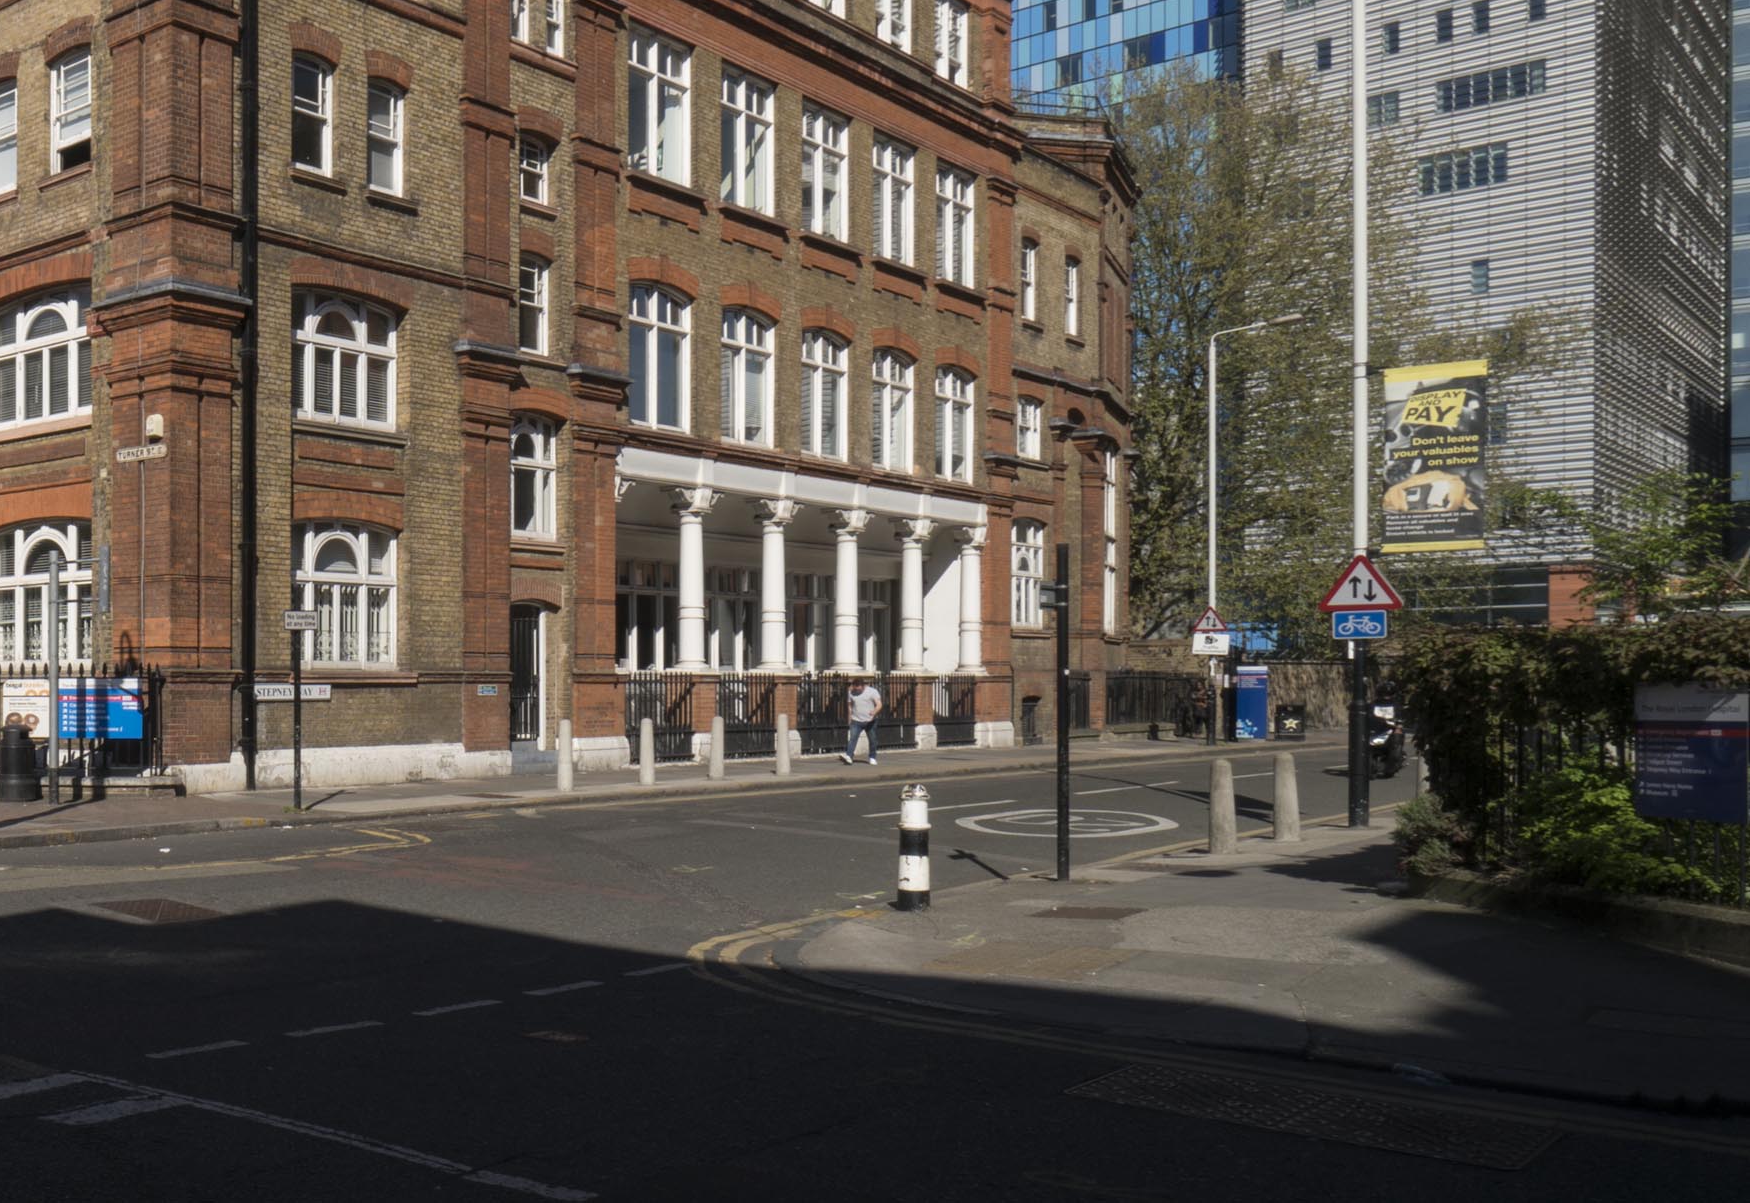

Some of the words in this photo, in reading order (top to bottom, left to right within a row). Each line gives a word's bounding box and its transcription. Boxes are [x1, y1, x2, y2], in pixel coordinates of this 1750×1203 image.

[1409, 391, 1462, 403] DISPLAY
[1418, 399, 1441, 407] AND
[1404, 405, 1457, 423] PAY
[1412, 436, 1445, 446] Don't
[1446, 434, 1479, 444] leave
[1393, 449, 1420, 460] your
[1422, 445, 1480, 457] valuables
[1427, 458, 1443, 467] on
[1446, 456, 1480, 466] show
[295, 613, 316, 621] loading
[256, 687, 293, 697] STEPNEY
